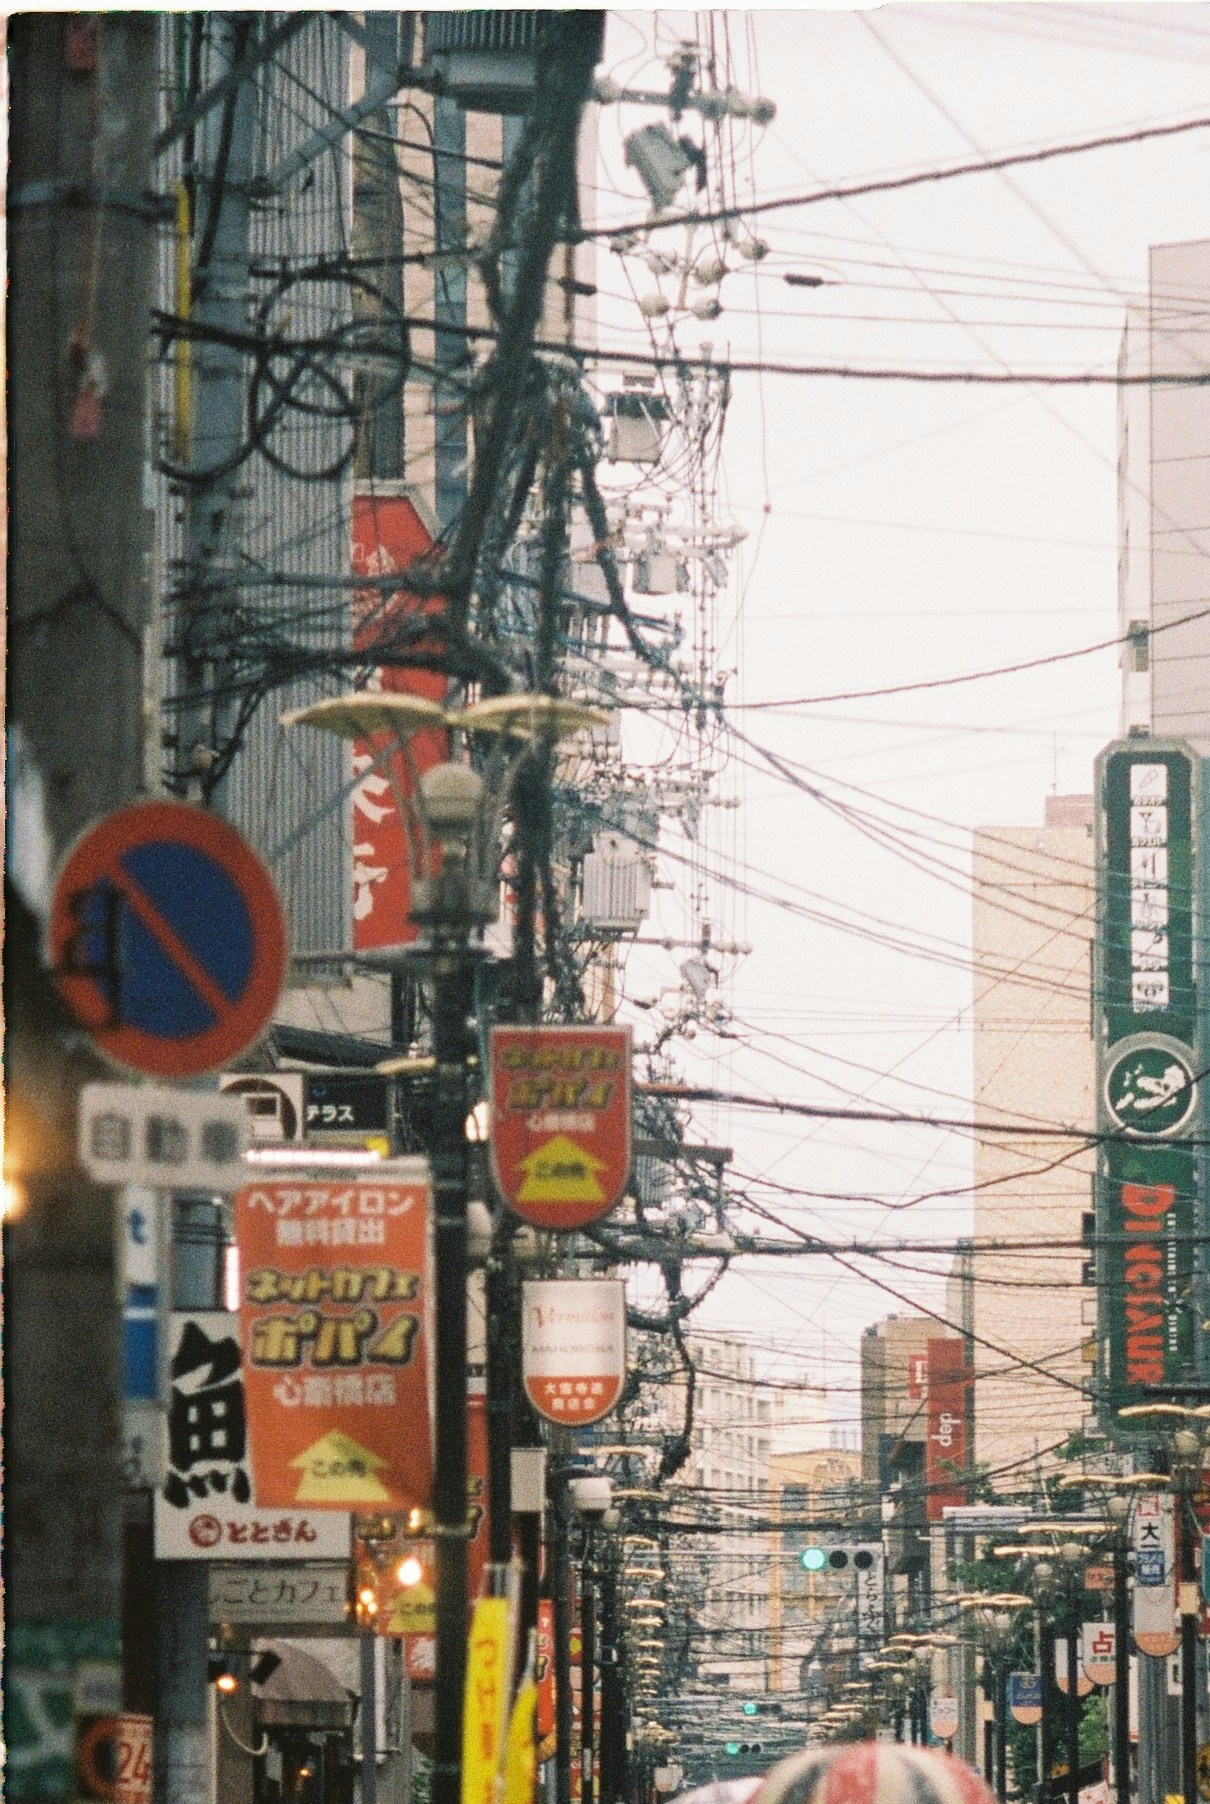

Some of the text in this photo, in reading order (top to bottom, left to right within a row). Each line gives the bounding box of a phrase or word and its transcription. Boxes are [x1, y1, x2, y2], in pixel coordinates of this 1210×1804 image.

[248, 1189, 414, 1216] ヘアアイロン
[248, 1268, 420, 1304] ネットカフェ
[252, 1310, 418, 1366] ポパイ
[930, 1413, 961, 1447] dep
[227, 1519, 318, 1544] ととぎん
[1092, 1630, 1115, 1654] 占
